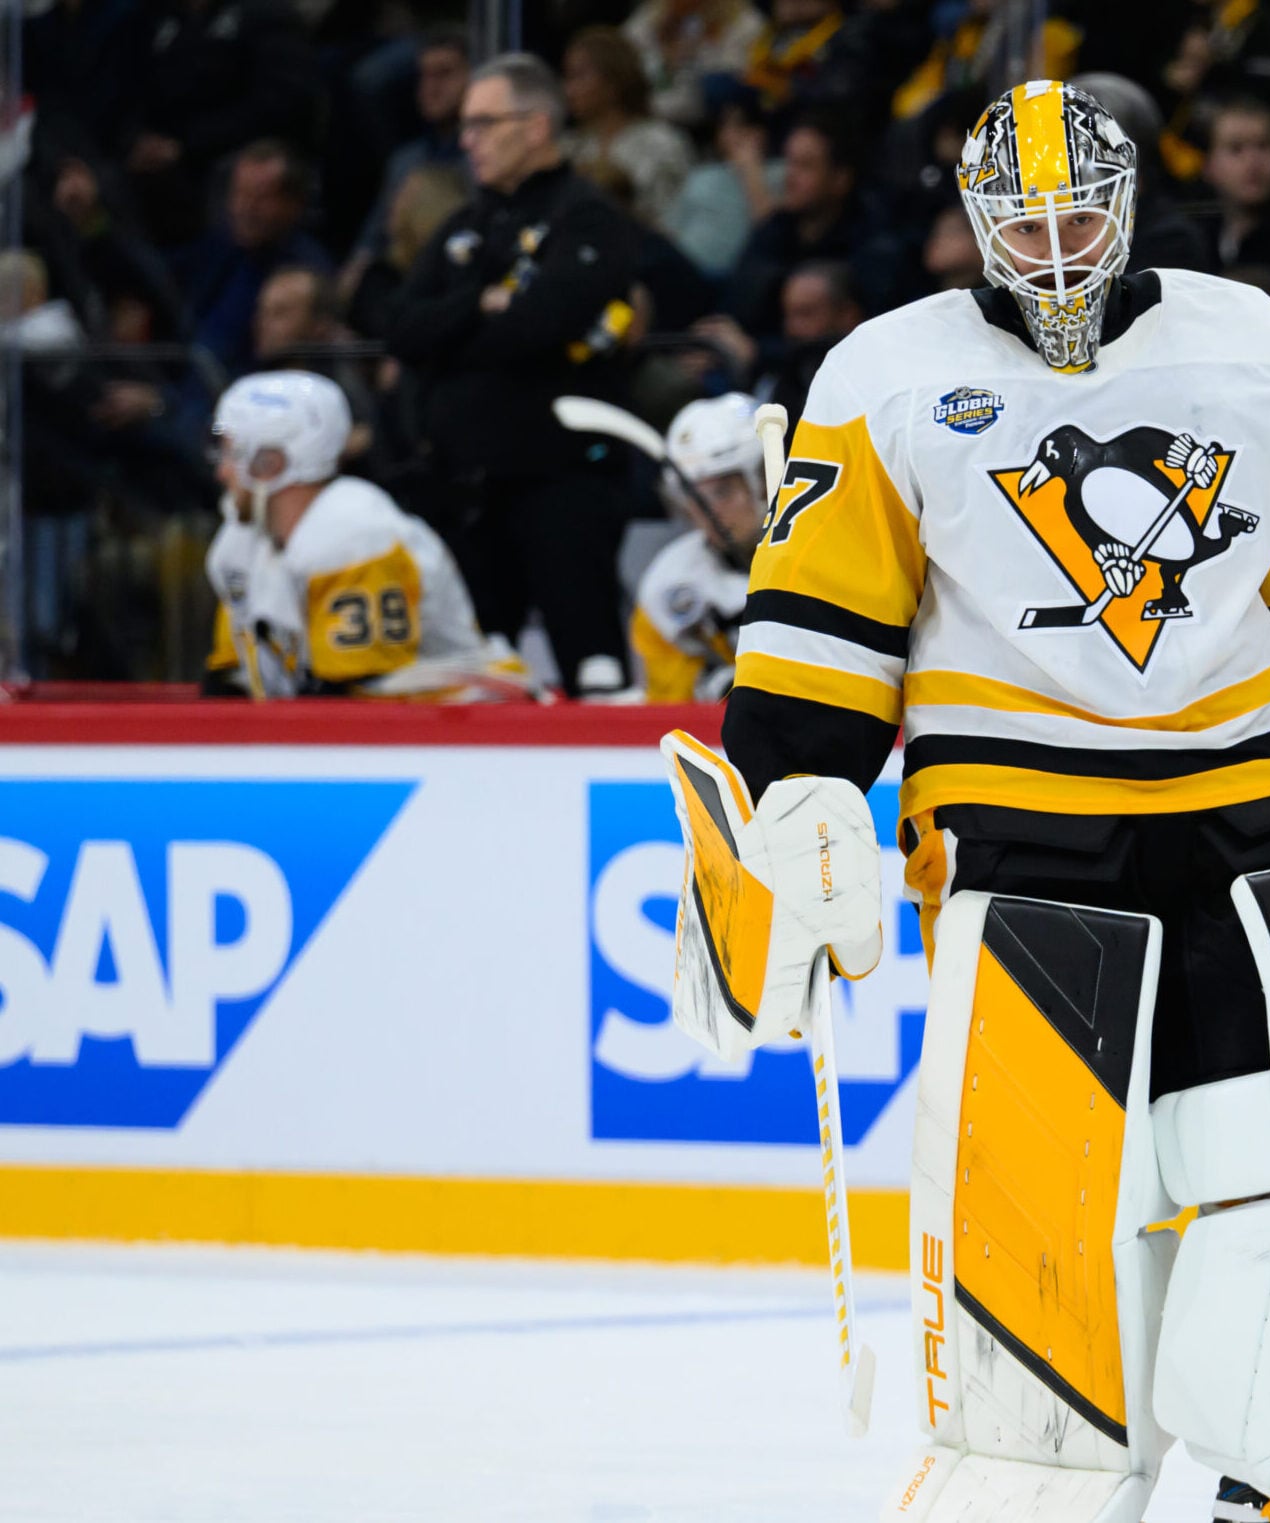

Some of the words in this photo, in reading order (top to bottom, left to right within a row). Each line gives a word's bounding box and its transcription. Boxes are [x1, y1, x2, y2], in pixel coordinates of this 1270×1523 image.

[934, 395, 1004, 422] GLOBAL
[946, 407, 993, 425] SERIES
[328, 586, 413, 649] 39
[922, 1232, 950, 1429] TRUE
